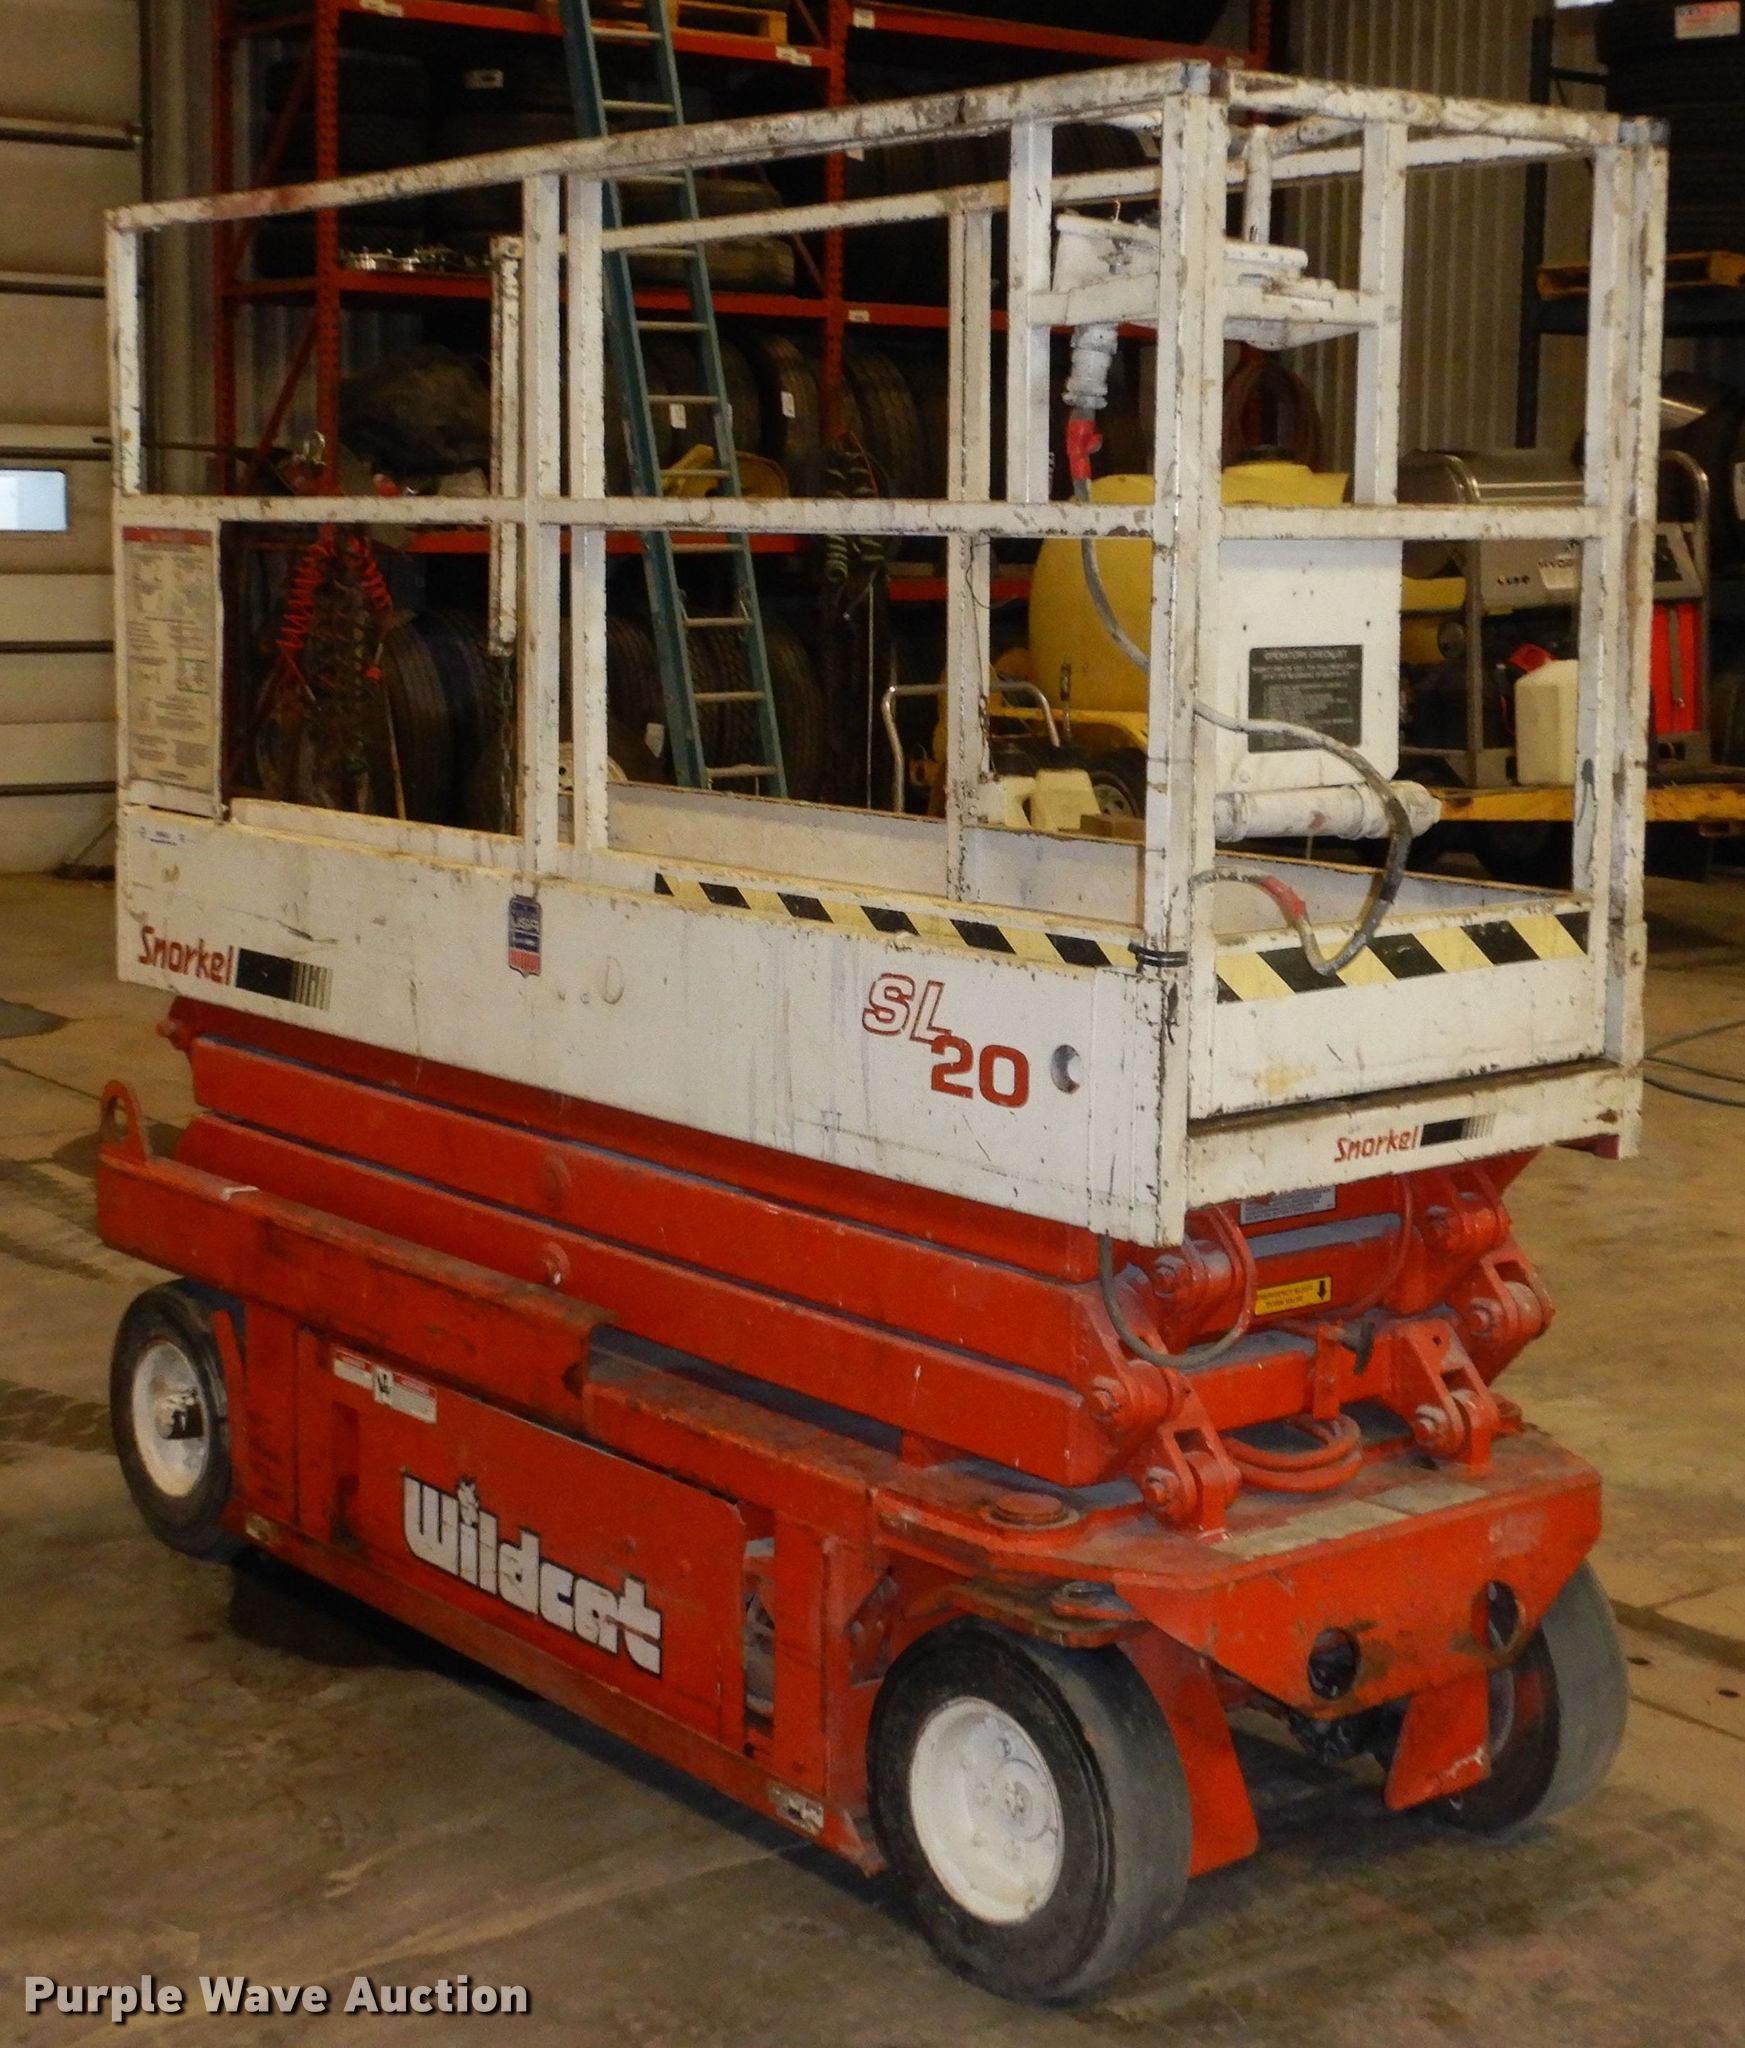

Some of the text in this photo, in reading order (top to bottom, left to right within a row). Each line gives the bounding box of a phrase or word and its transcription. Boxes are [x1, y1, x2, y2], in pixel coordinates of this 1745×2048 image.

[138, 925, 235, 986] Snorkel
[862, 973, 952, 1045] SL
[930, 1035, 1030, 1108] 20
[1334, 1125, 1419, 1163] Snorkel
[402, 1473, 663, 1677] Wildcat
